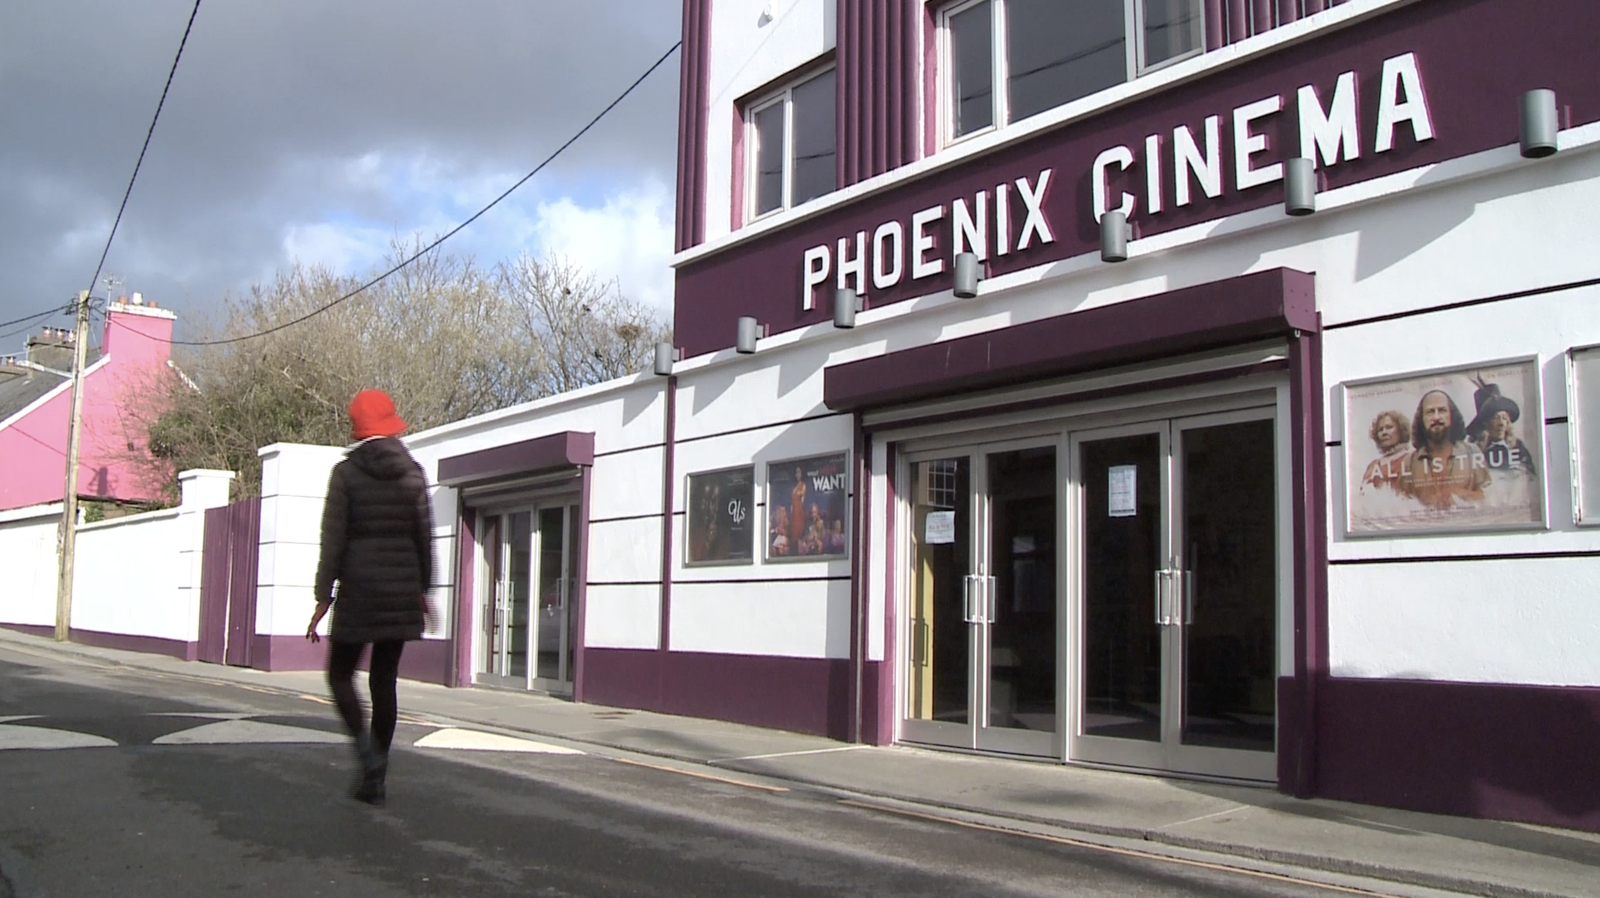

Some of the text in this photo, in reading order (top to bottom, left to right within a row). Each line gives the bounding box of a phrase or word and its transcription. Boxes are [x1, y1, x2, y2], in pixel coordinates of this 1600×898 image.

[802, 52, 1436, 311] PHOENIX CINEMA
[1370, 448, 1521, 480] ALL IS TRUE
[813, 473, 846, 492] WANT
